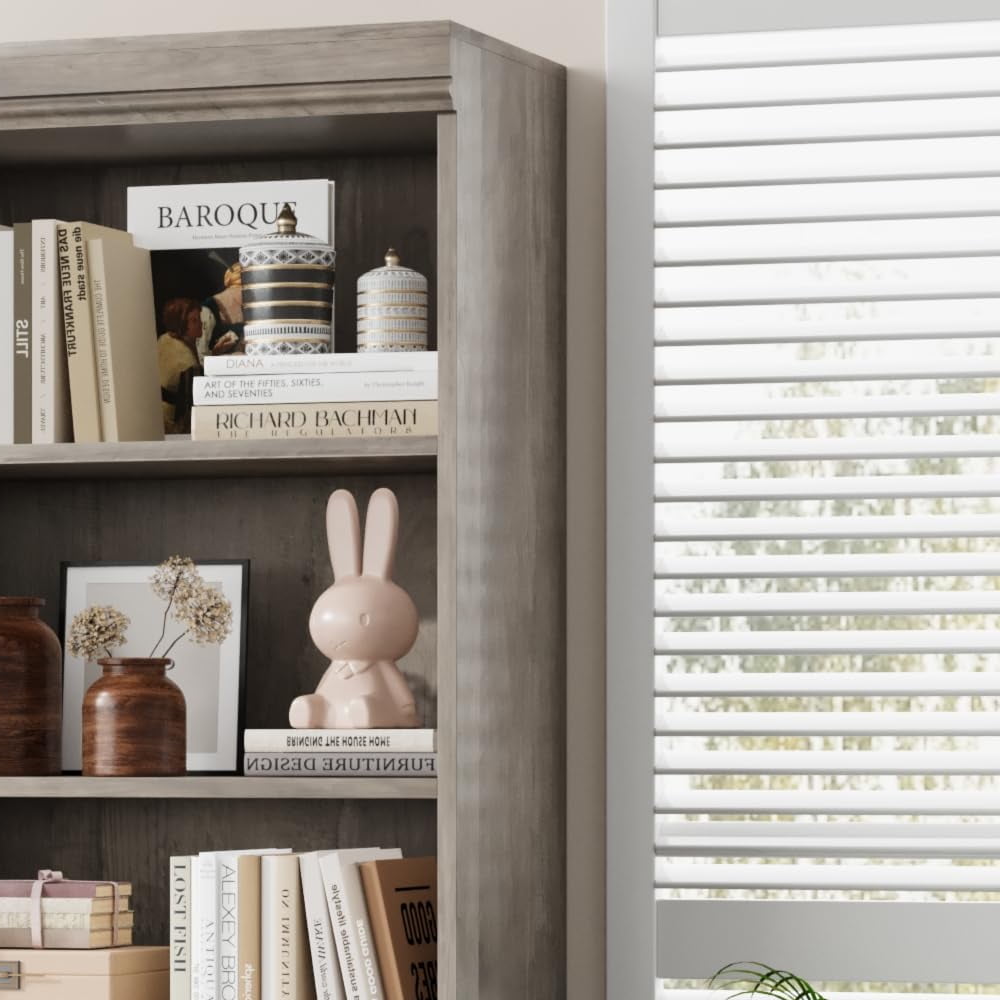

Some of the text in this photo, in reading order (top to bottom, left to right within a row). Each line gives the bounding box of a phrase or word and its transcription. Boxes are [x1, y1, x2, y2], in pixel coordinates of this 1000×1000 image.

[226, 358, 264, 369] DIANA
[204, 380, 222, 389] ART
[223, 380, 236, 389] OF
[238, 379, 256, 389] THE
[204, 388, 273, 399] AND SEVENTIES
[216, 408, 417, 430] RICHARD BACHMAN
[221, 863, 236, 949] ALEXEY
[173, 864, 187, 972] LOST FISH
